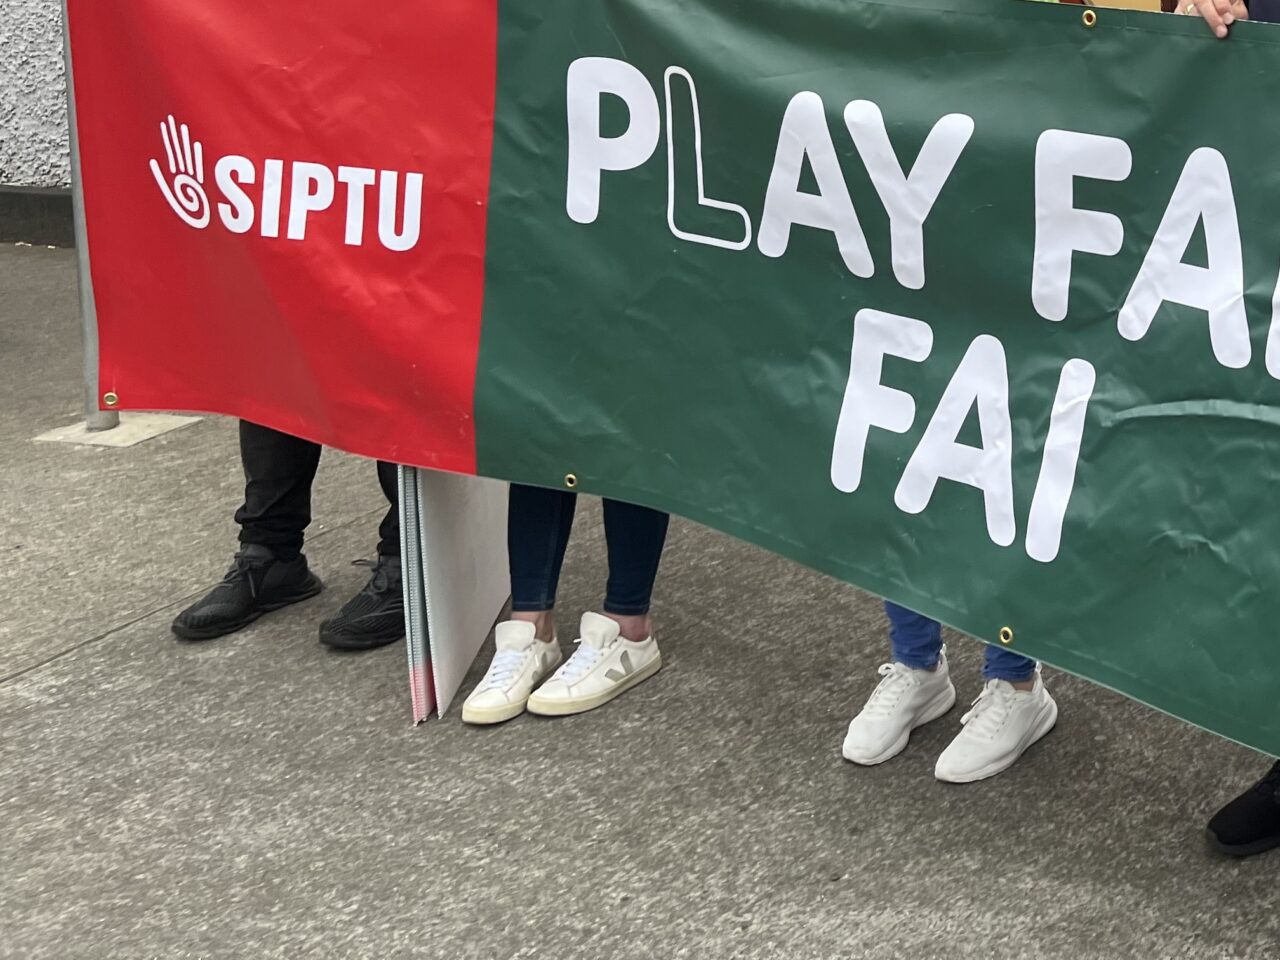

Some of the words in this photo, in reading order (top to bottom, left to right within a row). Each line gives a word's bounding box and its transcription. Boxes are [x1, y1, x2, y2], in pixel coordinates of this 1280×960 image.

[214, 155, 423, 251] SIPTU
[566, 57, 974, 290] PLAY
[831, 308, 1096, 563] FAI
